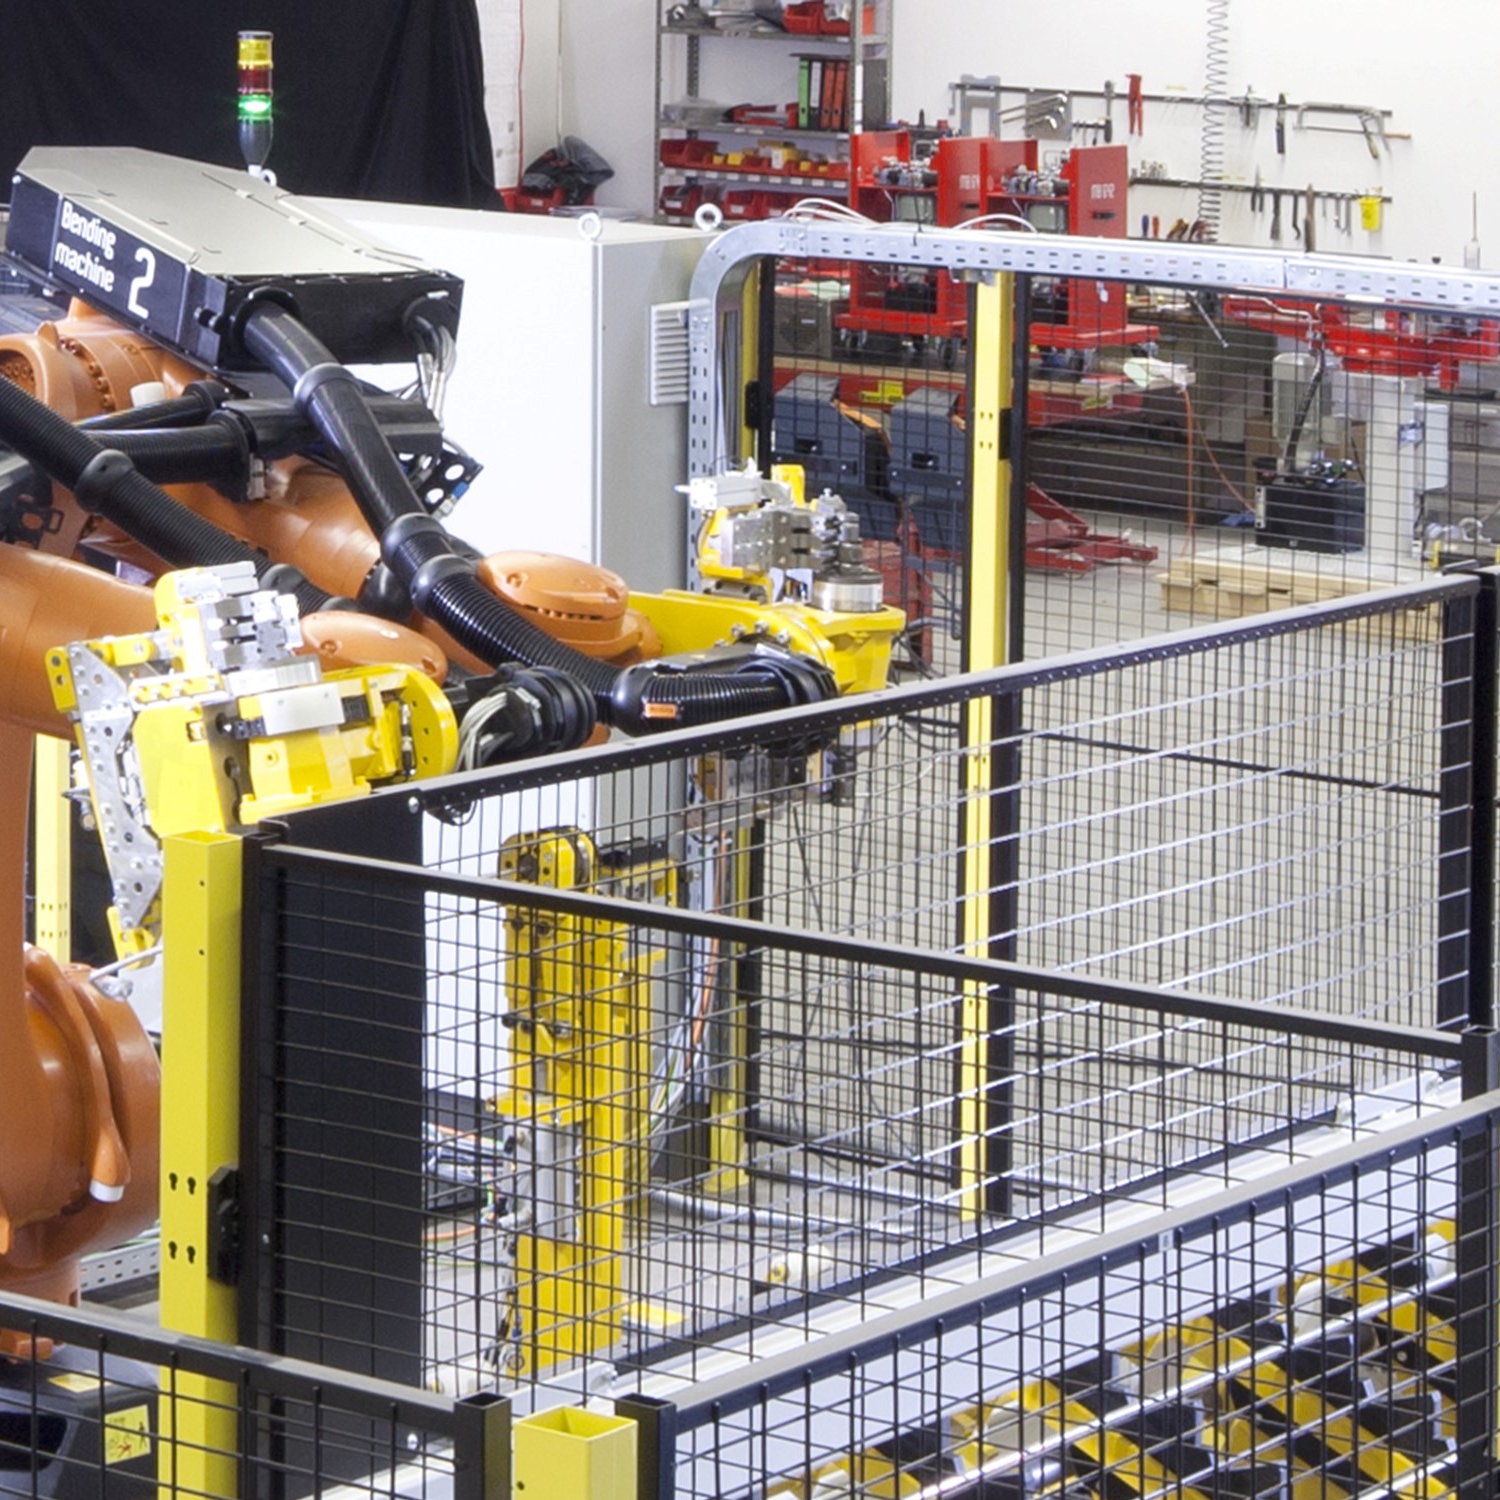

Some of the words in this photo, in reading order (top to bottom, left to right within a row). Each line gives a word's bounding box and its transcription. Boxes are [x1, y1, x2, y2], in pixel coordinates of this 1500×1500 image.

[61, 200, 116, 260] Bending
[54, 241, 115, 292] machine
[127, 247, 156, 319] 2
